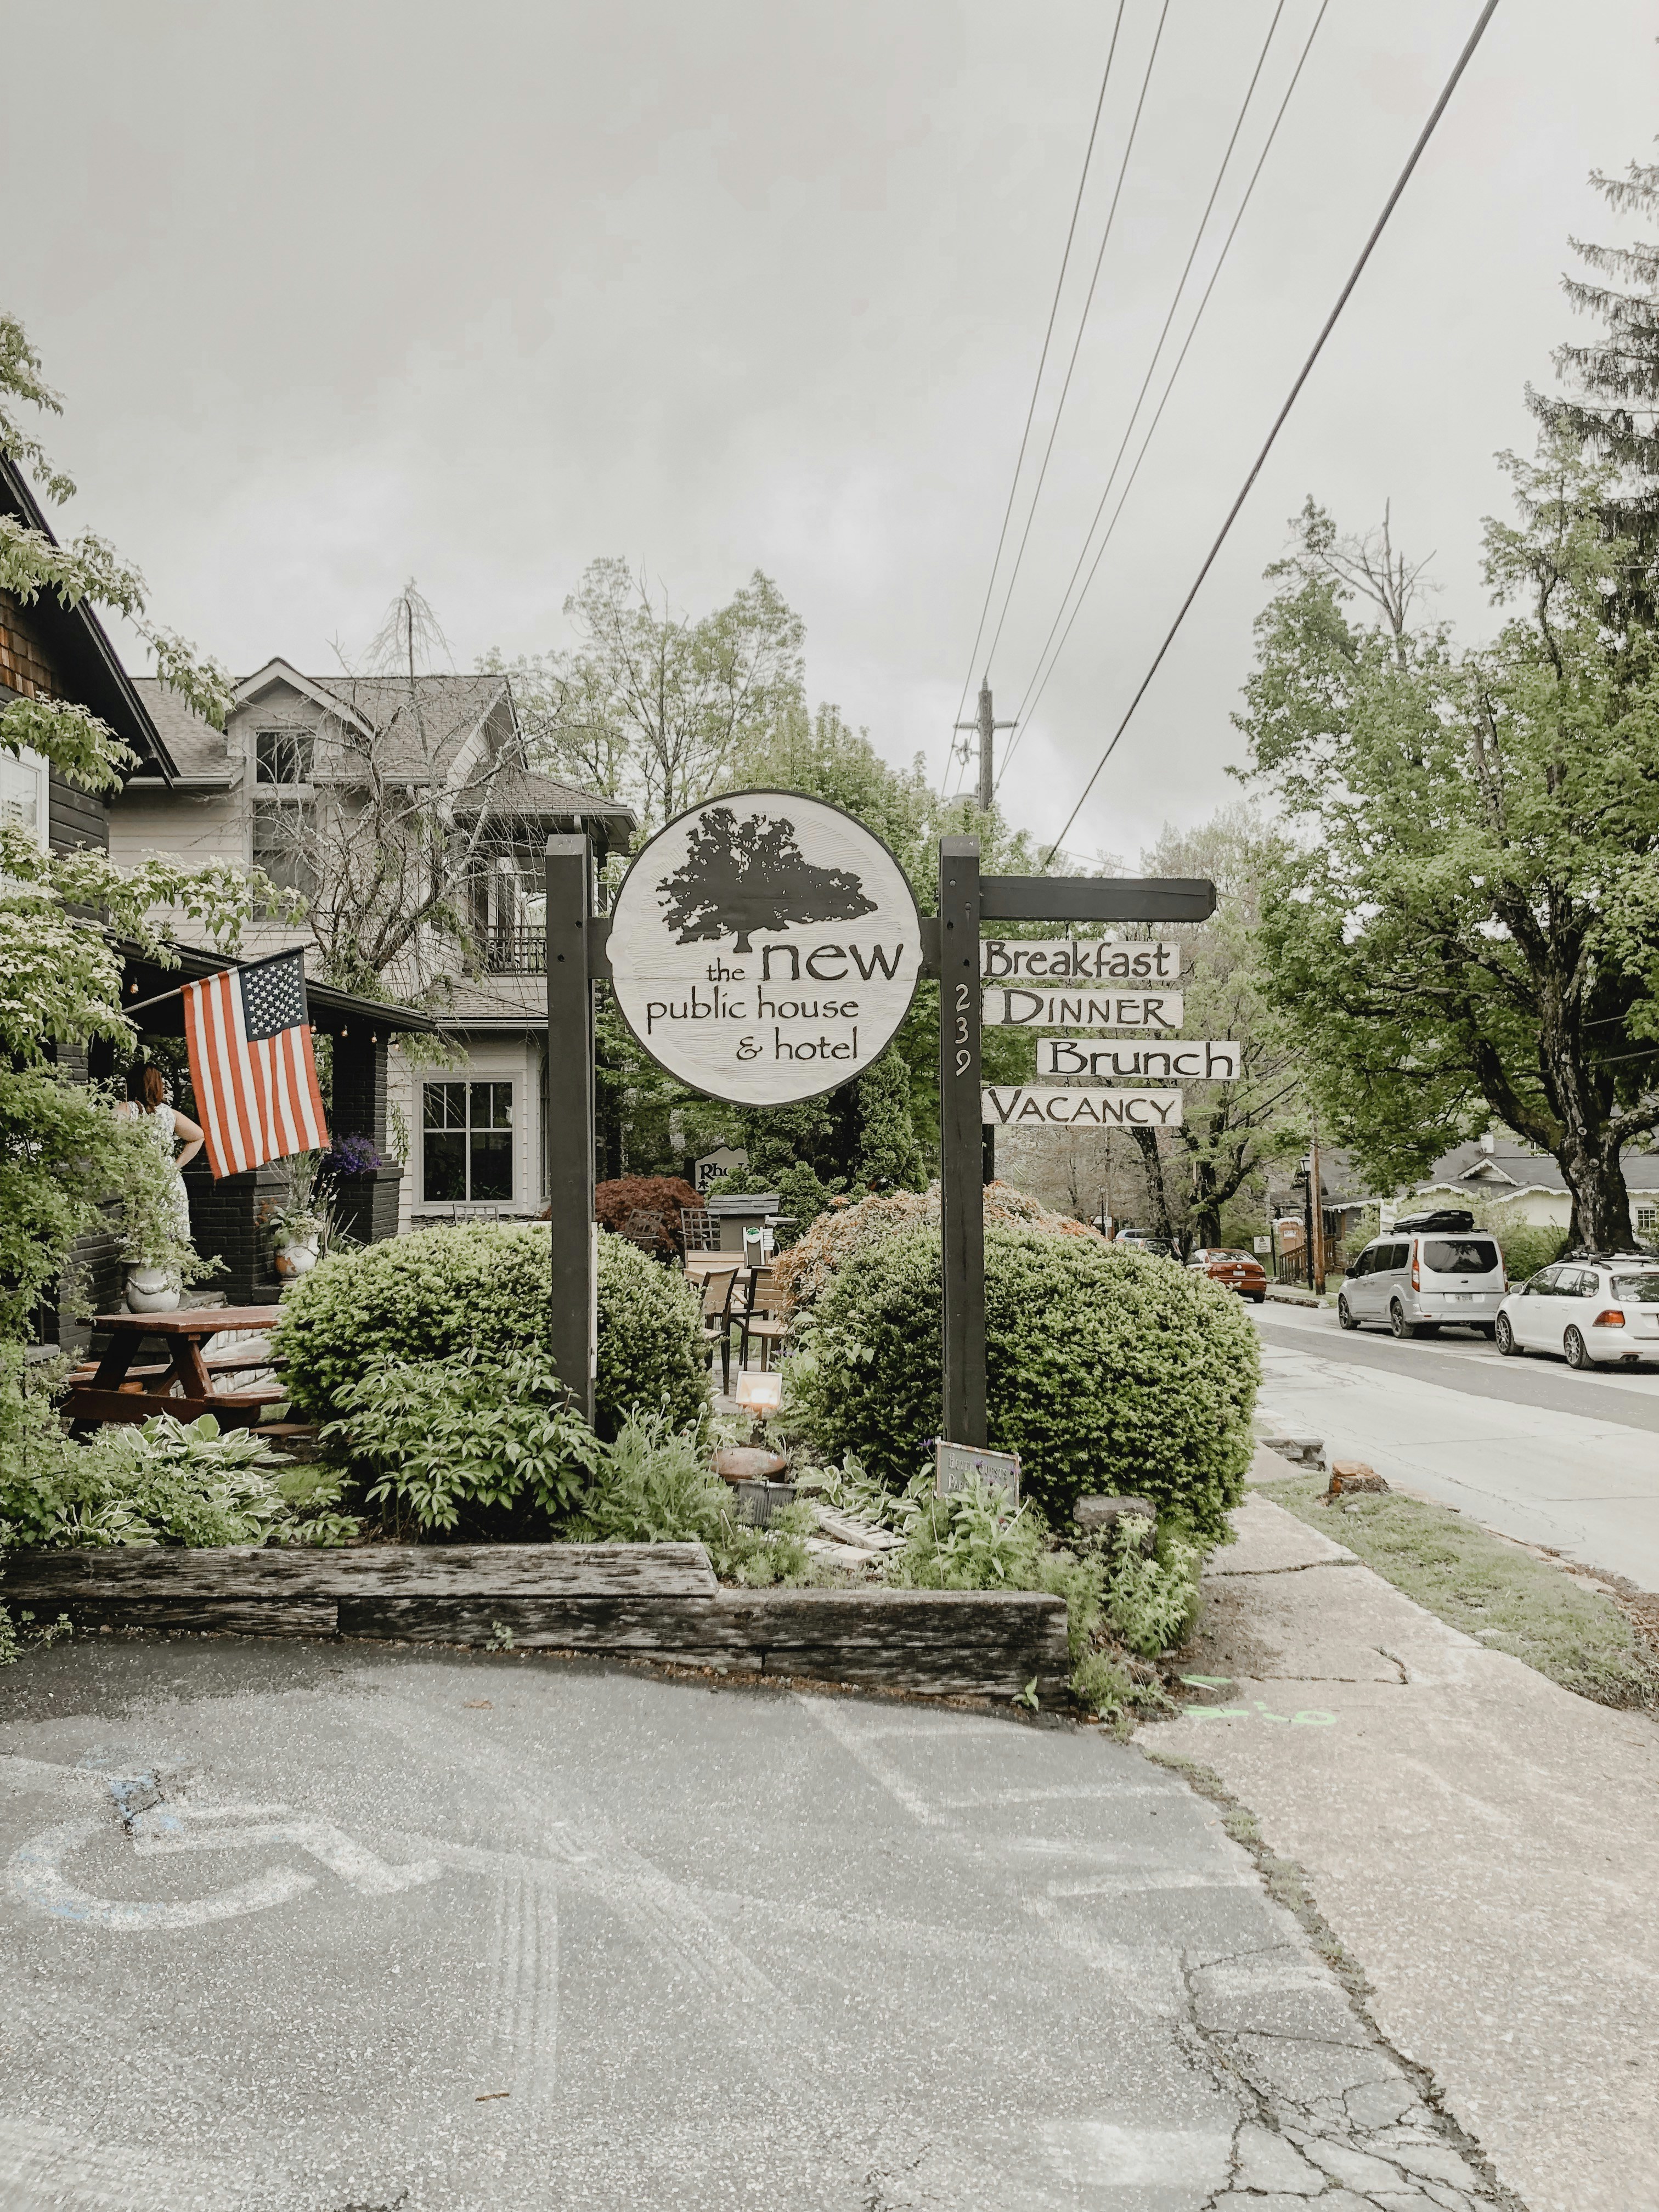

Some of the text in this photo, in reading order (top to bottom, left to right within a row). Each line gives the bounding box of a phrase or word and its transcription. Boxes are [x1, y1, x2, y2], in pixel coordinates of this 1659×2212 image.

[706, 943, 904, 982] the new
[984, 941, 1170, 977] Breakfast
[647, 985, 859, 1035] public house
[1001, 989, 1175, 1028] DINNER
[736, 1026, 857, 1060] & hotel
[1048, 1042, 1233, 1078] Brunch
[988, 1089, 1176, 1125] VACANCY
